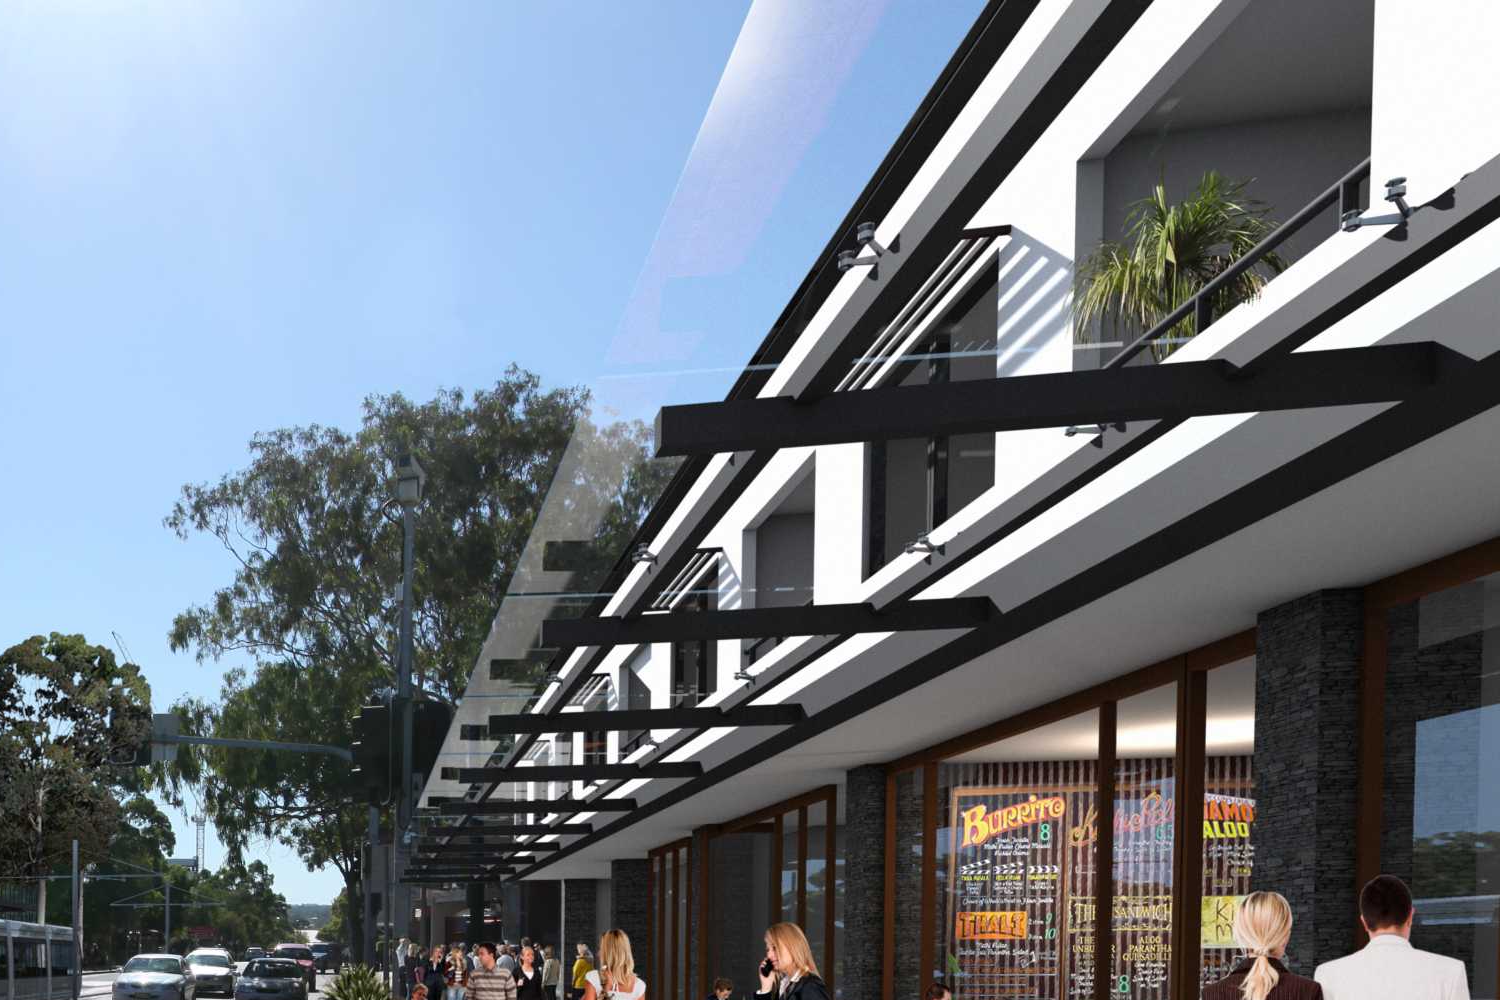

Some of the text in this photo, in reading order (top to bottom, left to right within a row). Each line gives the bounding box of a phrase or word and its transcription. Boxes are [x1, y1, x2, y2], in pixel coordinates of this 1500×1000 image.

[1040, 823, 1051, 842] 8
[1114, 902, 1172, 922] SANDWICH
[1044, 928, 1056, 940] 10
[1119, 975, 1130, 993] 8
